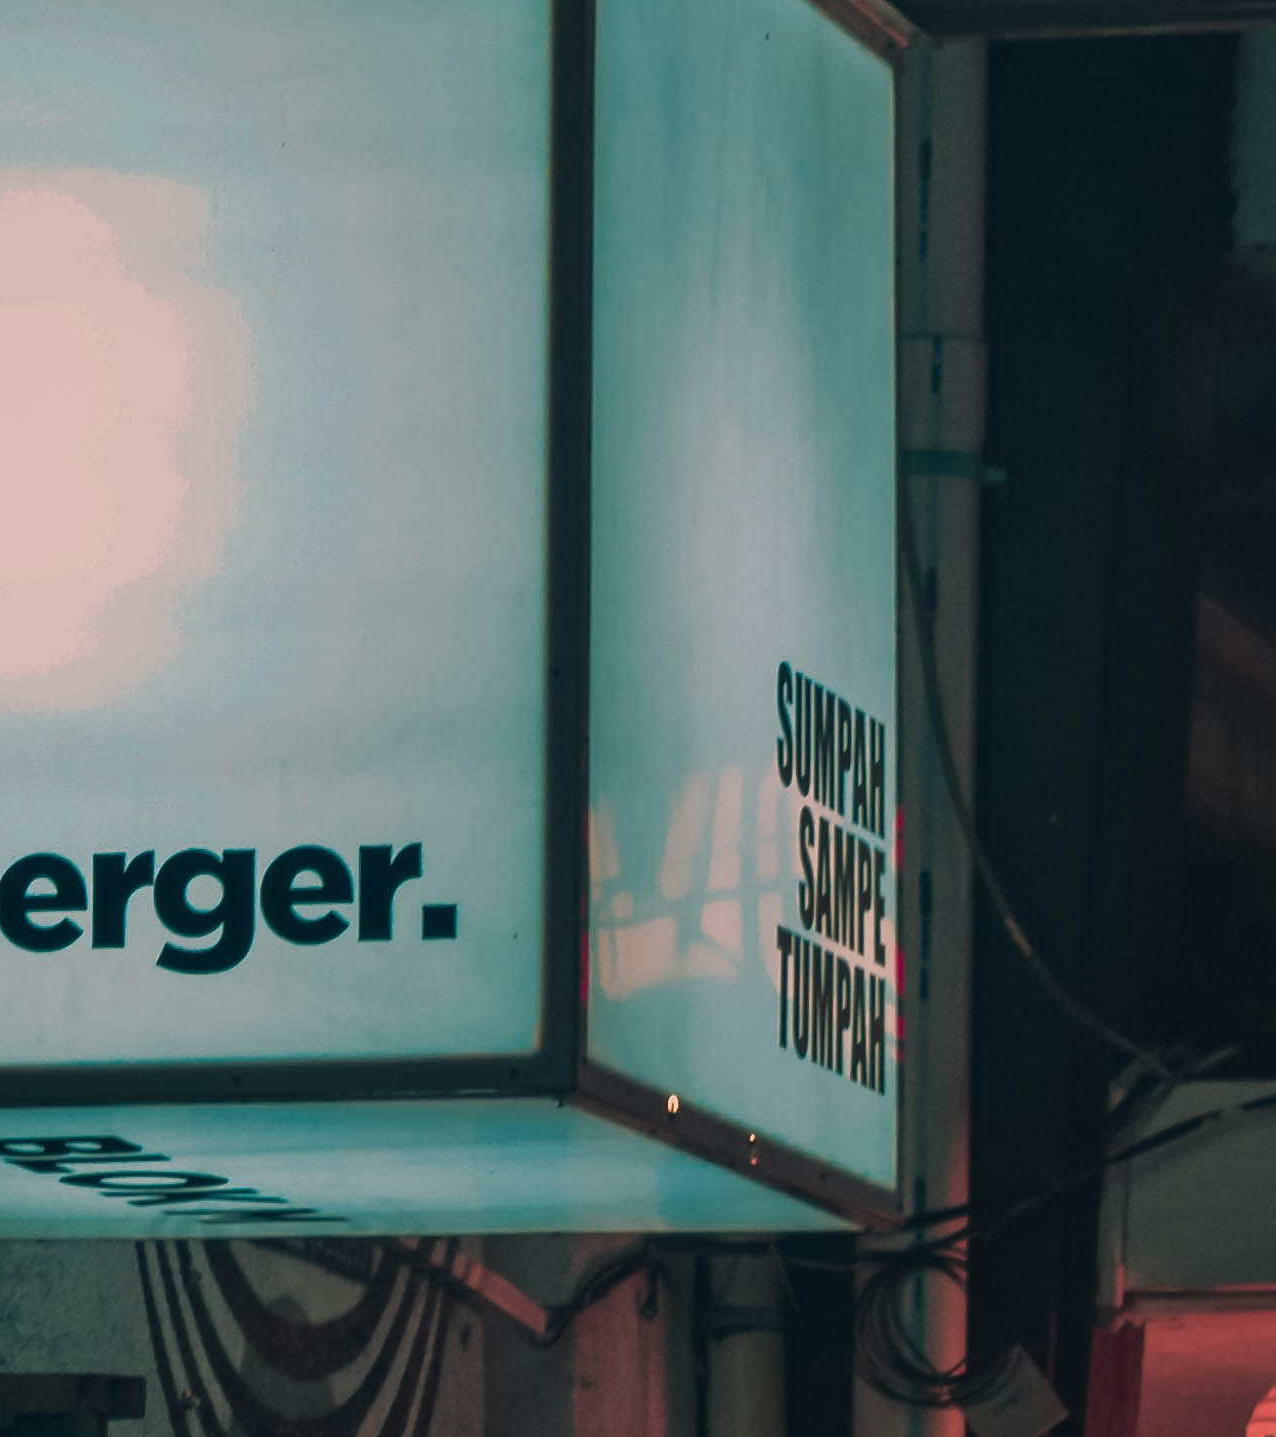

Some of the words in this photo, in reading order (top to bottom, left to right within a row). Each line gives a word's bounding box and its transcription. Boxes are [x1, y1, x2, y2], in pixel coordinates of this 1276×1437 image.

[776, 659, 886, 840] SUMPAH
[798, 805, 886, 968] SAMPE
[776, 924, 886, 1096] TUMPAH
